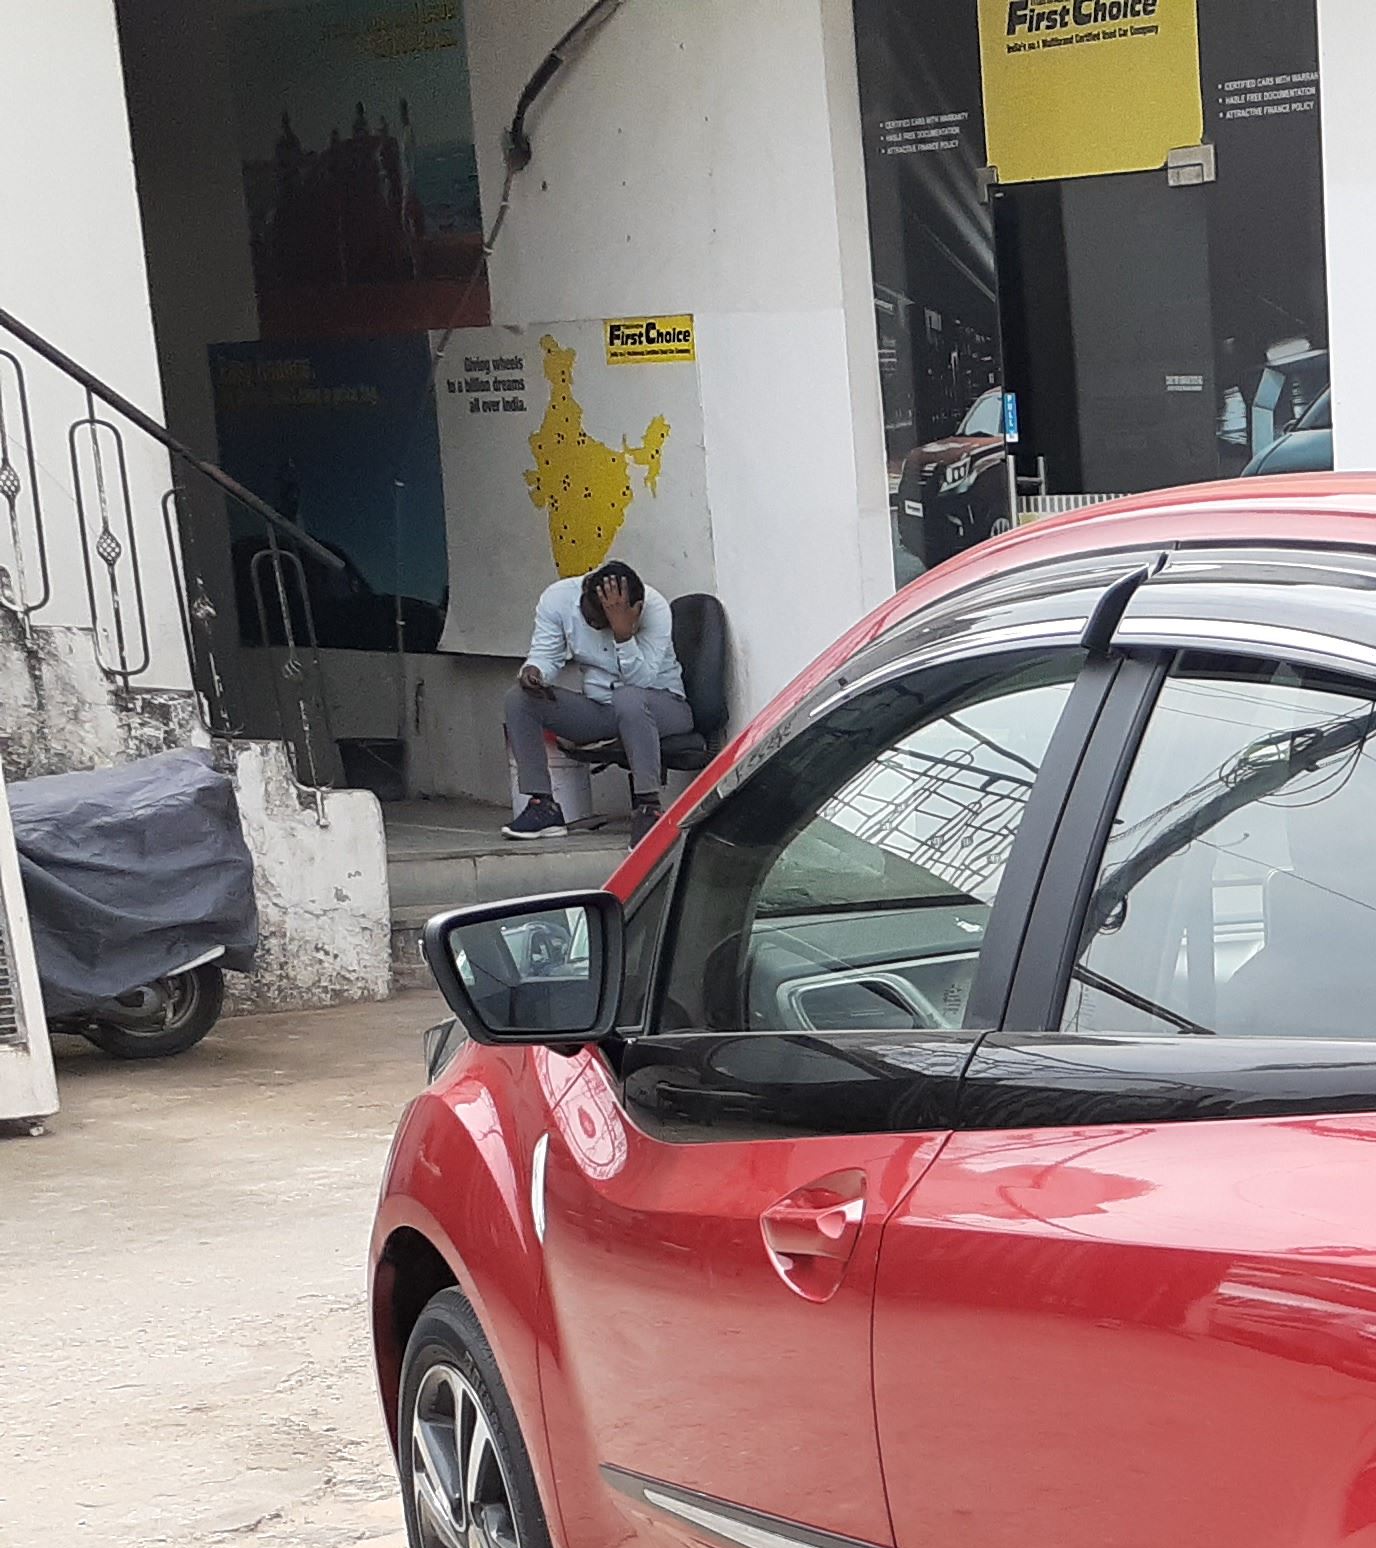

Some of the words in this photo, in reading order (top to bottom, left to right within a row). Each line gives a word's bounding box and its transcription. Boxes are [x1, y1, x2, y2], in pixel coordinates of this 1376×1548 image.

[1006, 0, 1070, 35] First
[609, 324, 643, 346] First
[645, 322, 691, 344] Choice
